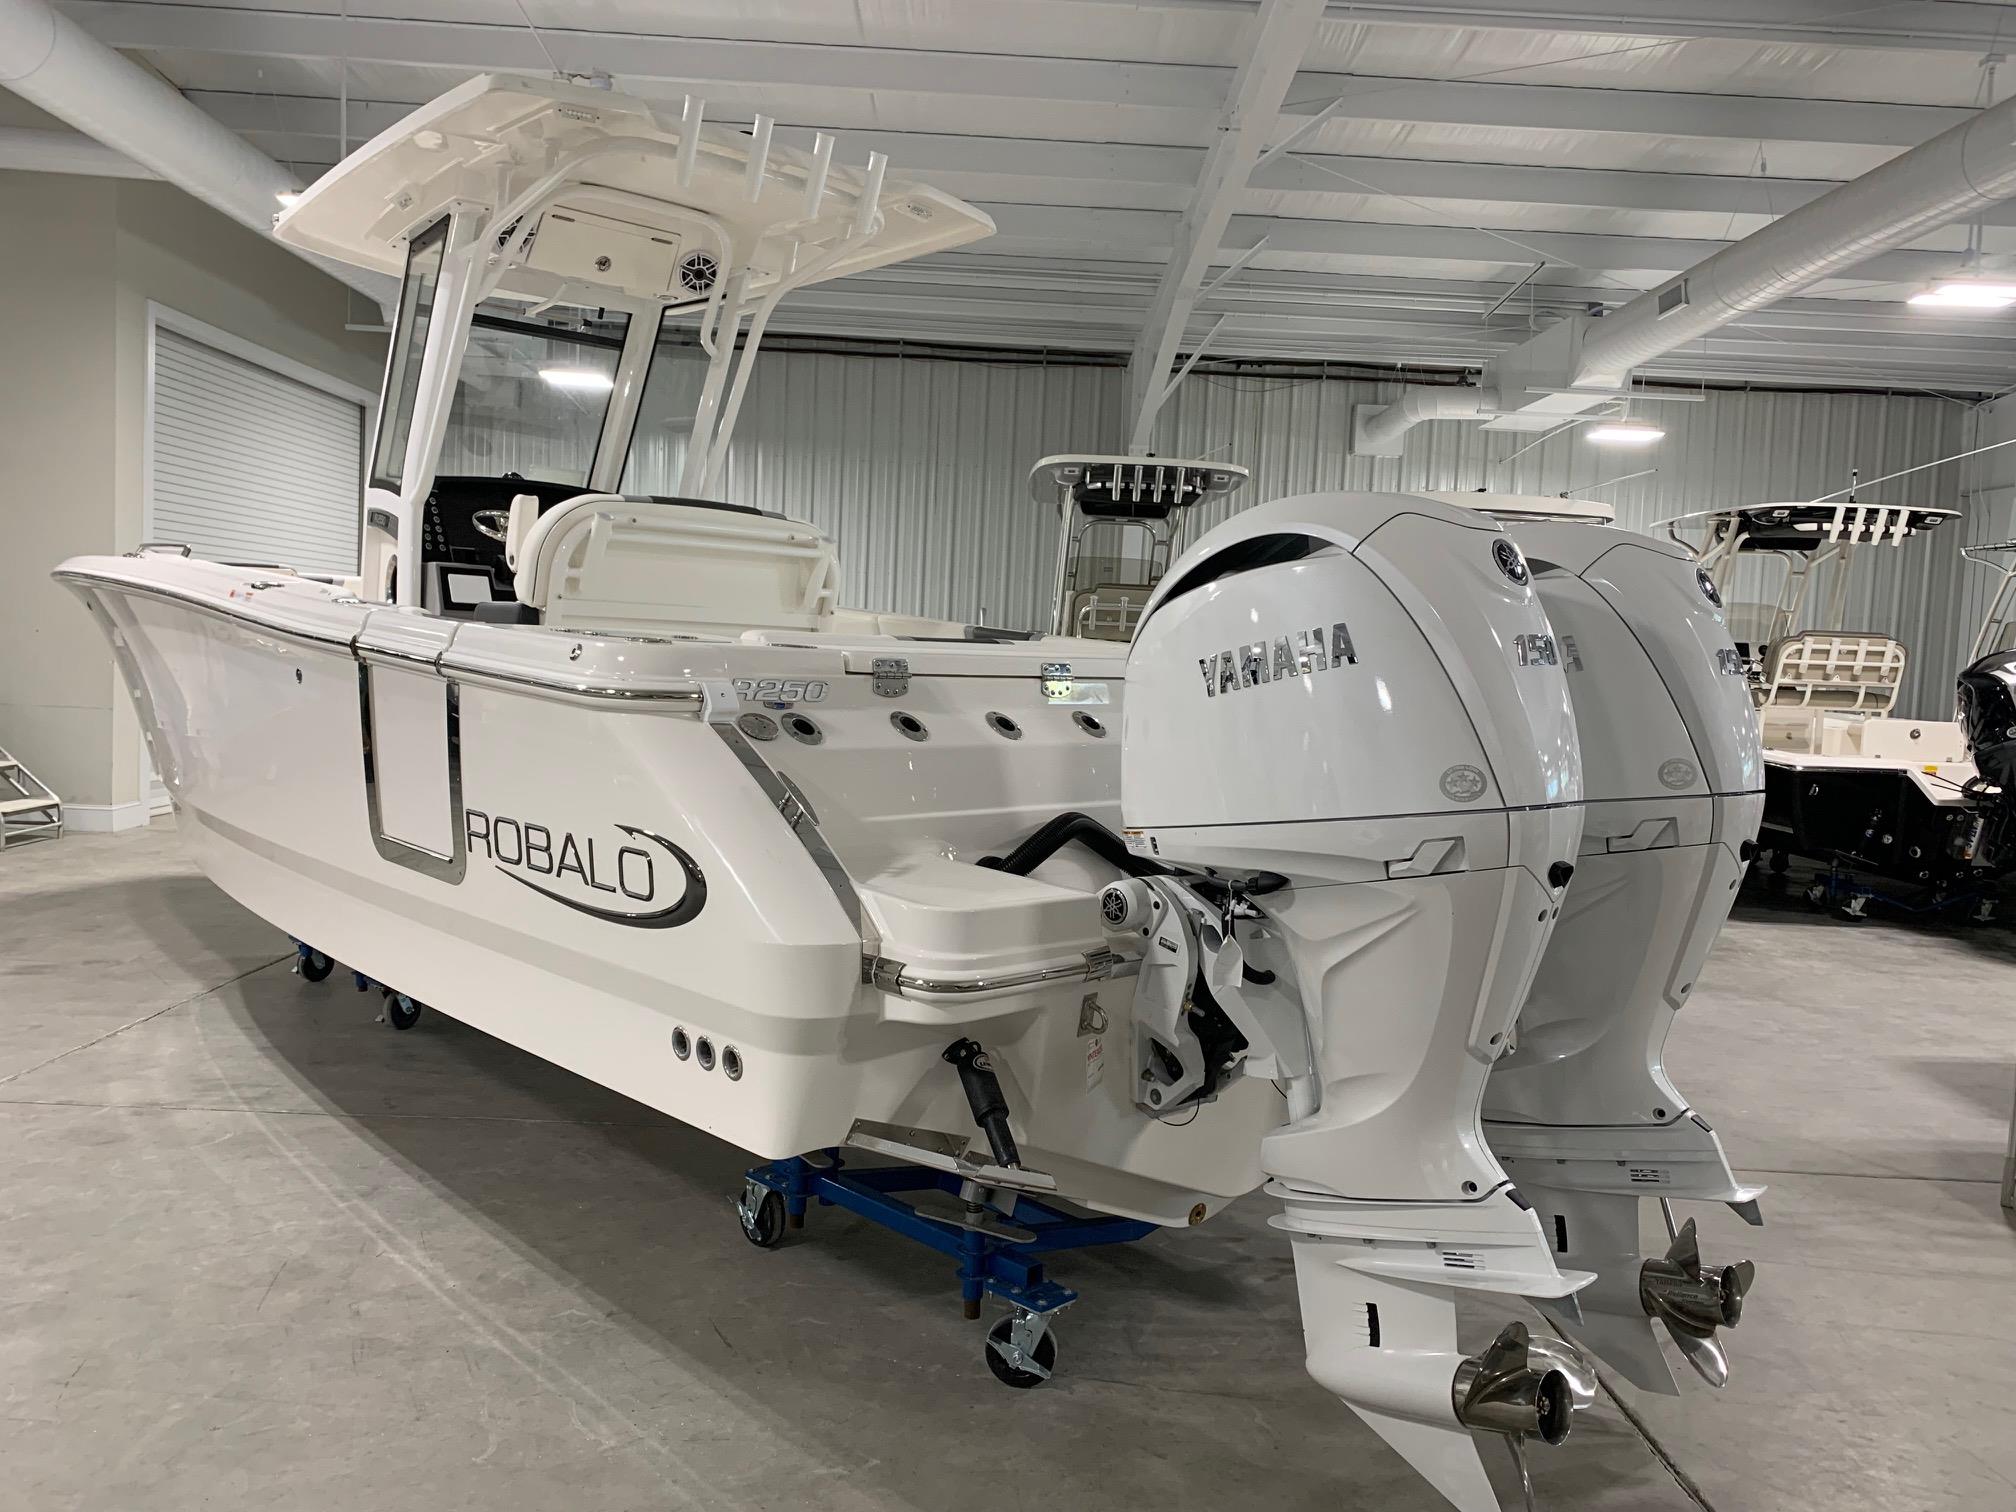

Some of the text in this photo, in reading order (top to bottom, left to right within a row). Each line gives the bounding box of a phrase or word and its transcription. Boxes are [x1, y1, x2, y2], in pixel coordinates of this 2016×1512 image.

[732, 678, 828, 703] R250
[1199, 622, 1359, 698] YAMAHA
[465, 808, 655, 902] ROBALO
